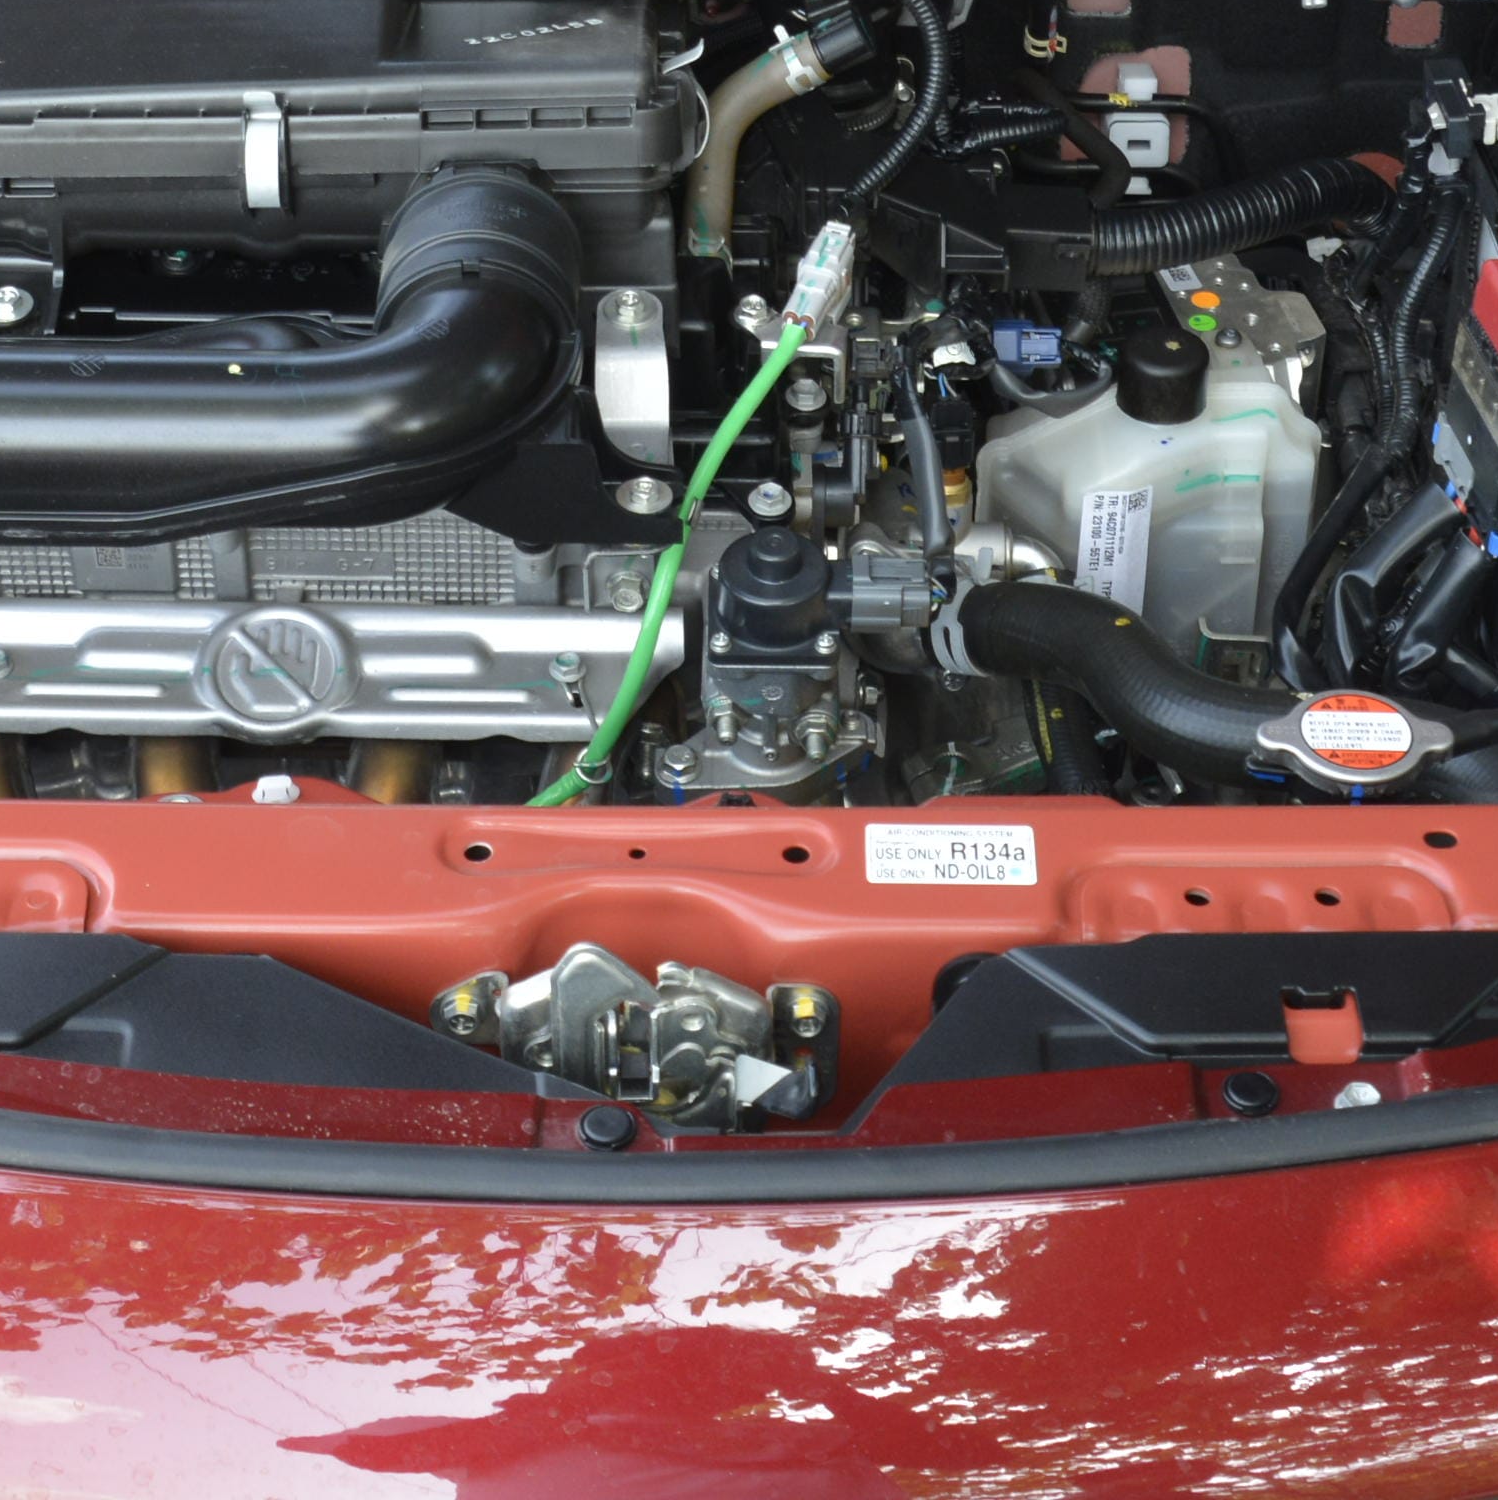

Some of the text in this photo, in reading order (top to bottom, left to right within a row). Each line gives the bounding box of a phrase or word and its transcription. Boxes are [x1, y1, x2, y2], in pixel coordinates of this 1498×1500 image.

[1093, 495, 1105, 512] P/N:
[1109, 495, 1119, 508] TR:
[1101, 580, 1113, 600] TYP
[876, 842, 1025, 861] USE ONLY R134a
[877, 864, 1006, 880] USE ONLY ND-OIL8
